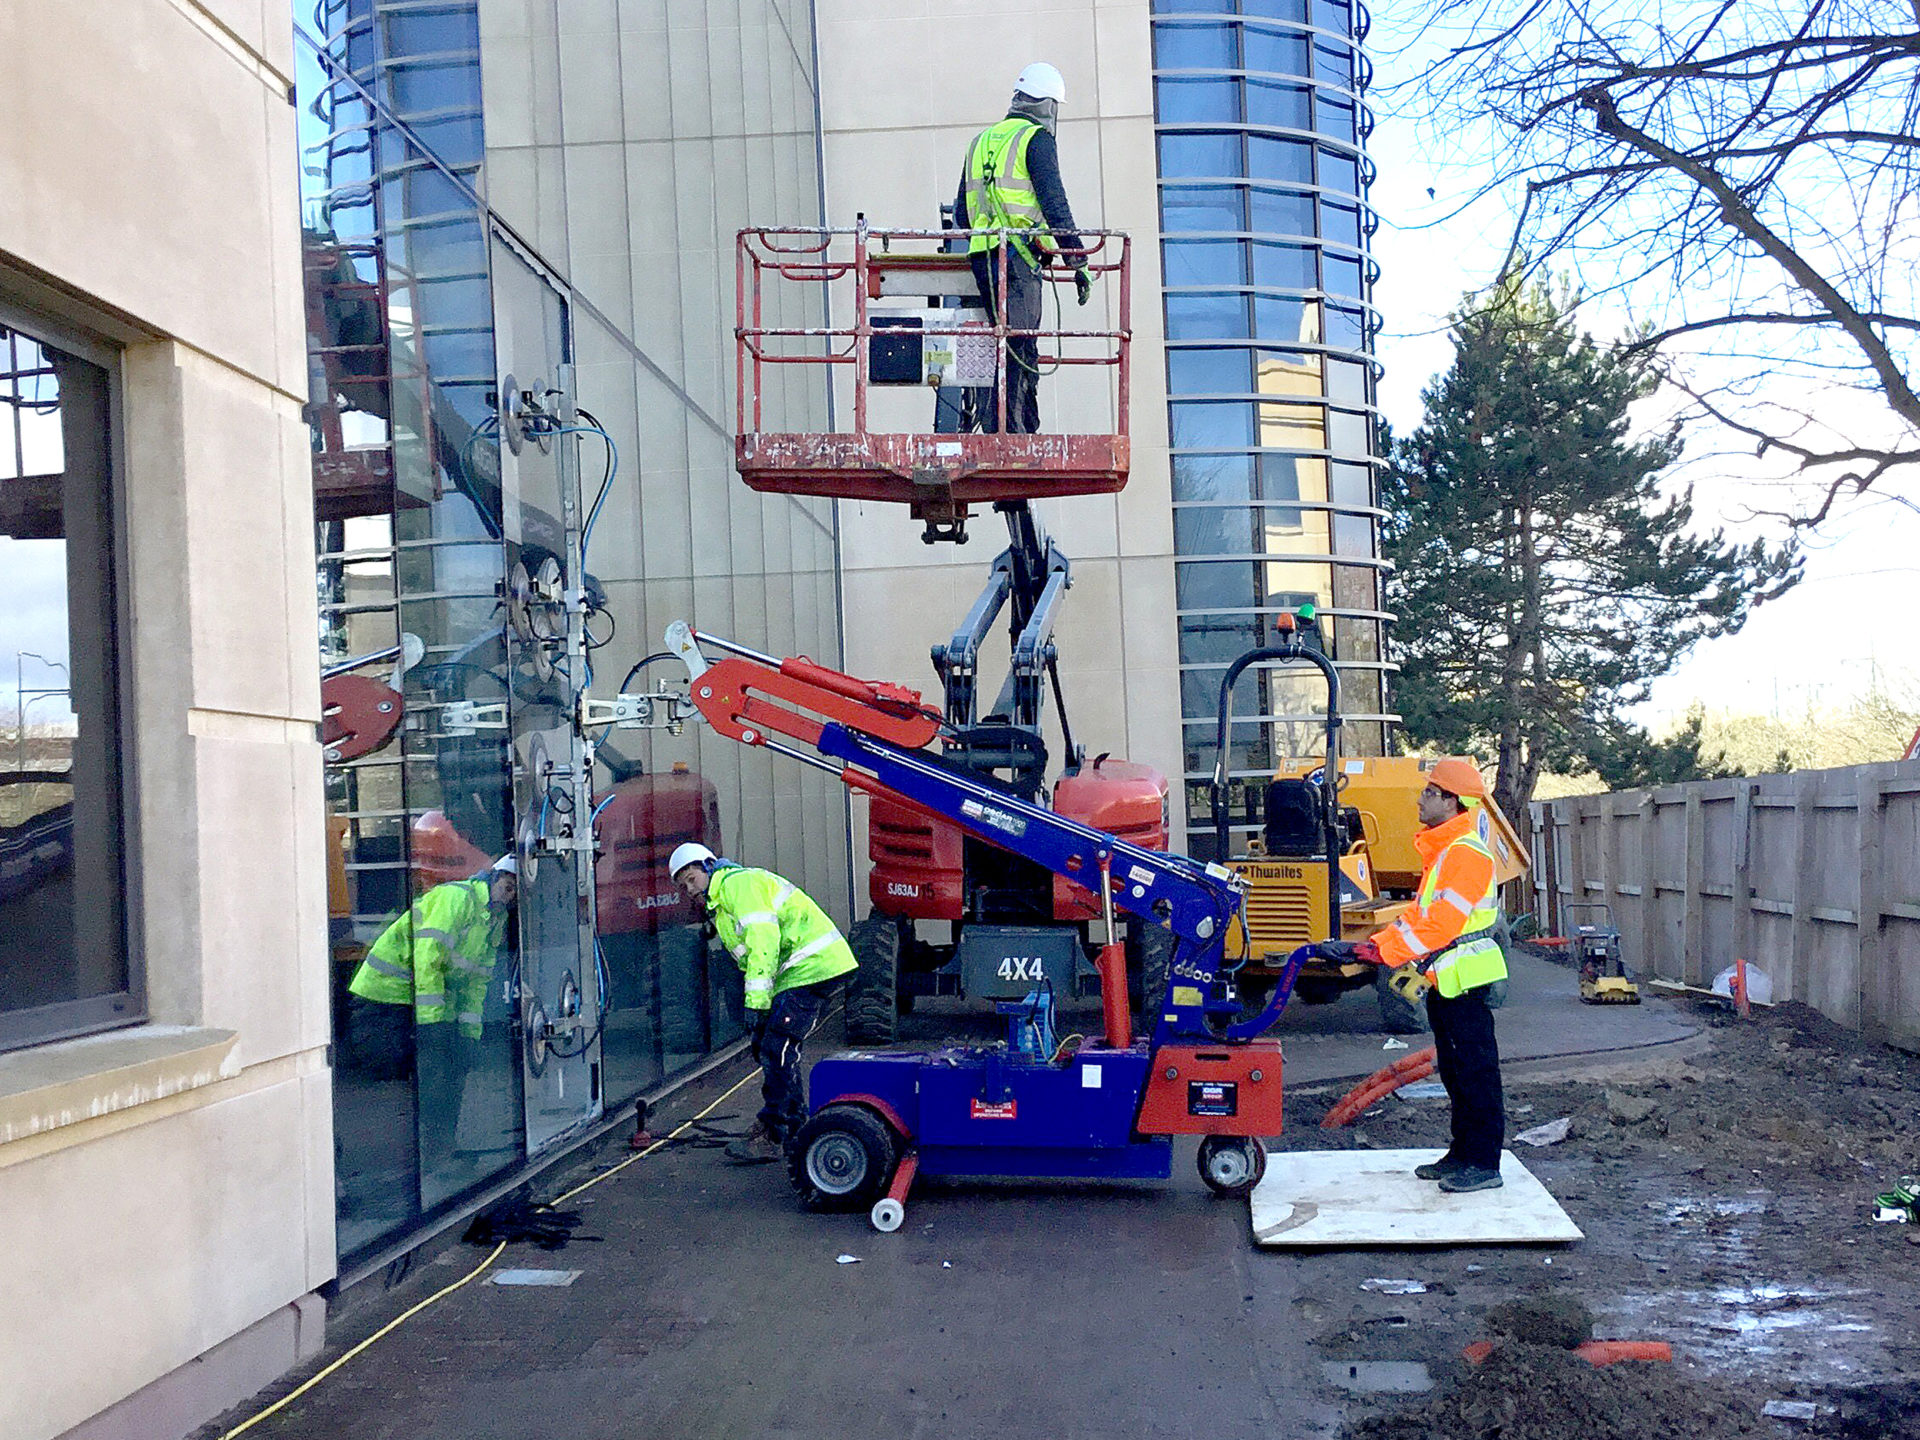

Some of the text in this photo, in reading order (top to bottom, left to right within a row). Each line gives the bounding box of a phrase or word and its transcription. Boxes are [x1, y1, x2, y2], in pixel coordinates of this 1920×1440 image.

[1250, 864, 1303, 879] Thwaites
[888, 882, 919, 898] SJ63AJ
[997, 957, 1044, 981] 4X4
